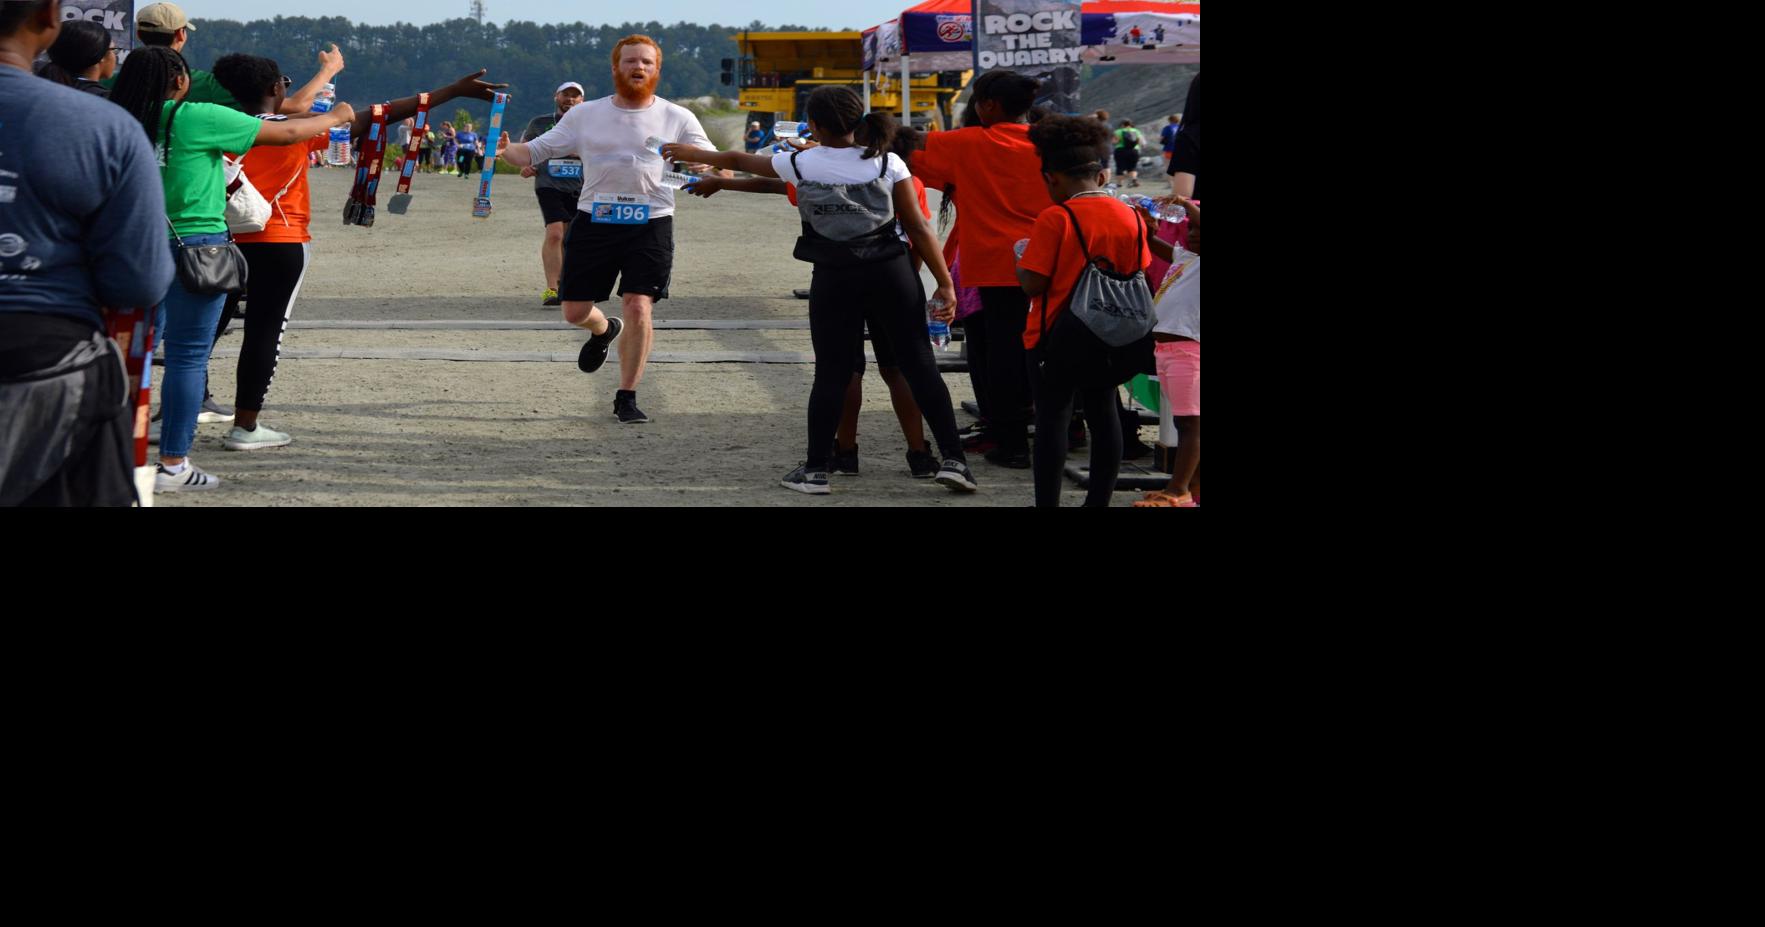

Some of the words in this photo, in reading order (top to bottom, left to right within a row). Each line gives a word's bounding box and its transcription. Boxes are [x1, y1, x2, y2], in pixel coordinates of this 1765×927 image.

[61, 6, 127, 30] OCK
[985, 11, 1076, 34] ROCK
[1001, 32, 1052, 50] THE
[979, 46, 1087, 69] QUARRY
[562, 166, 580, 175] 537
[616, 205, 645, 221] 196
